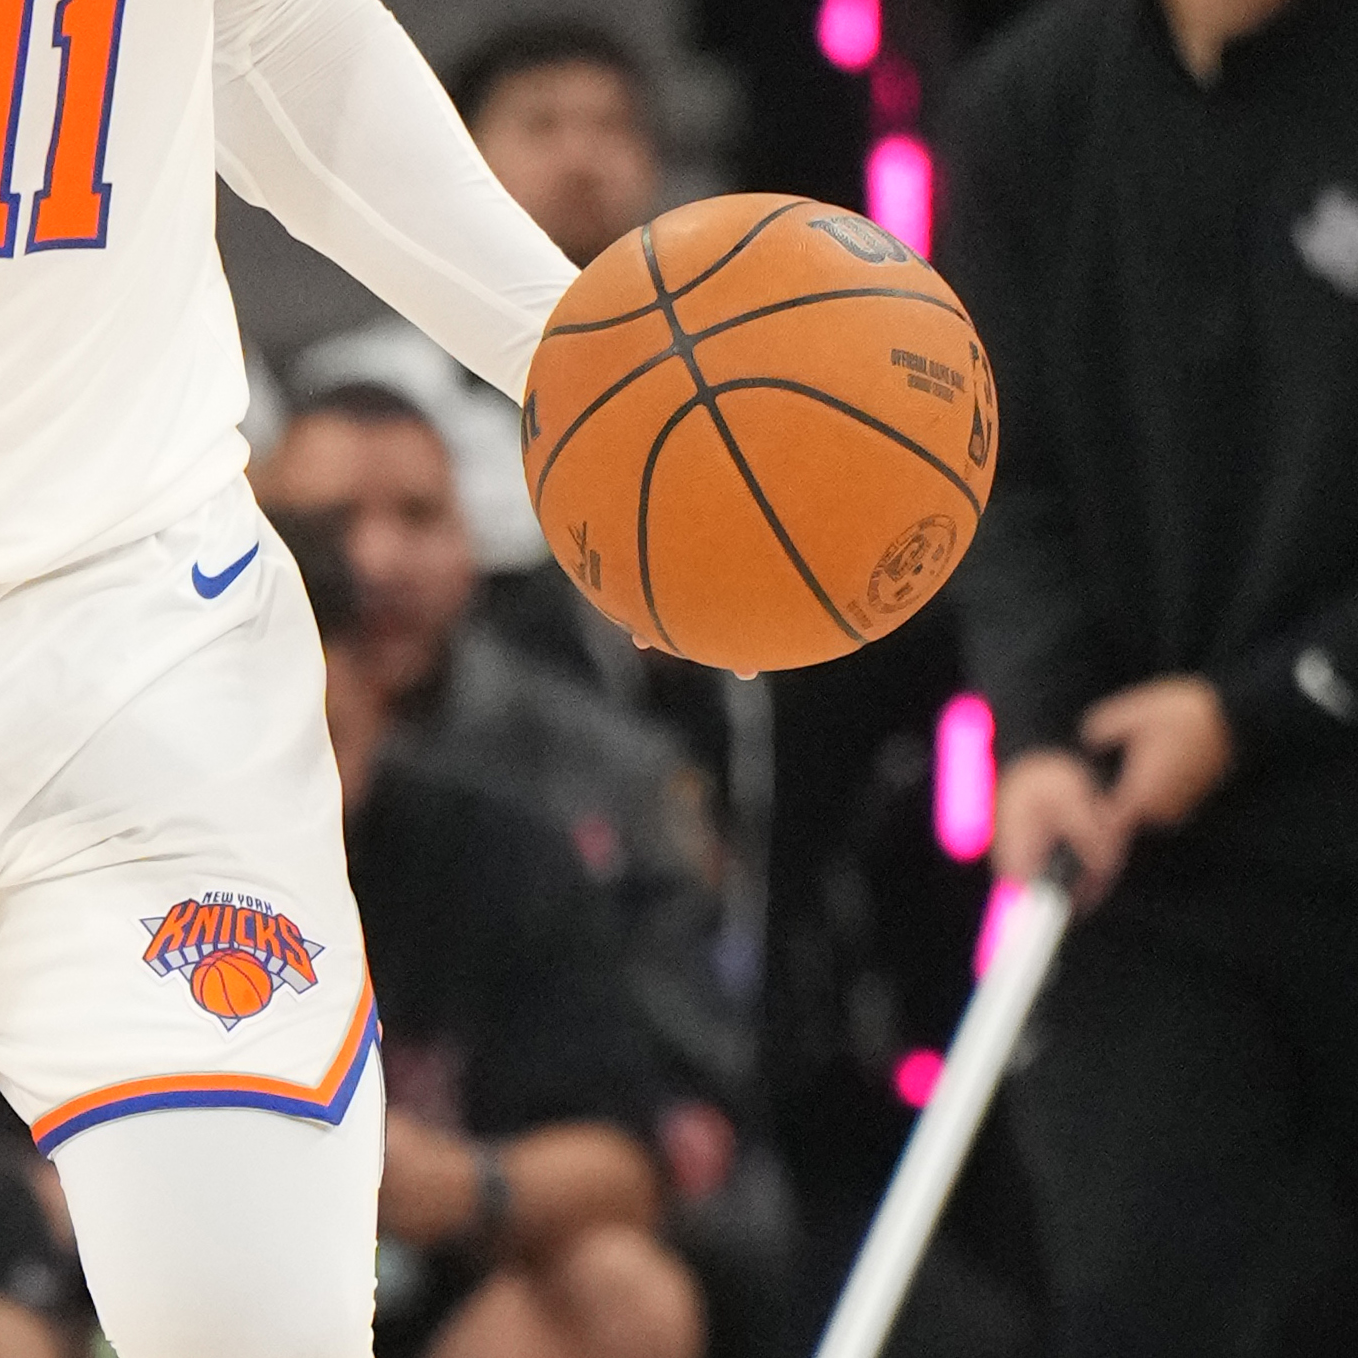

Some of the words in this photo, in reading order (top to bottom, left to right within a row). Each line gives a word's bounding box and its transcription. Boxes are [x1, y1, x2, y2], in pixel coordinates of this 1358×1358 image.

[202, 891, 233, 904] NEW
[238, 893, 274, 915] YORK
[143, 898, 318, 990] KNICKS
